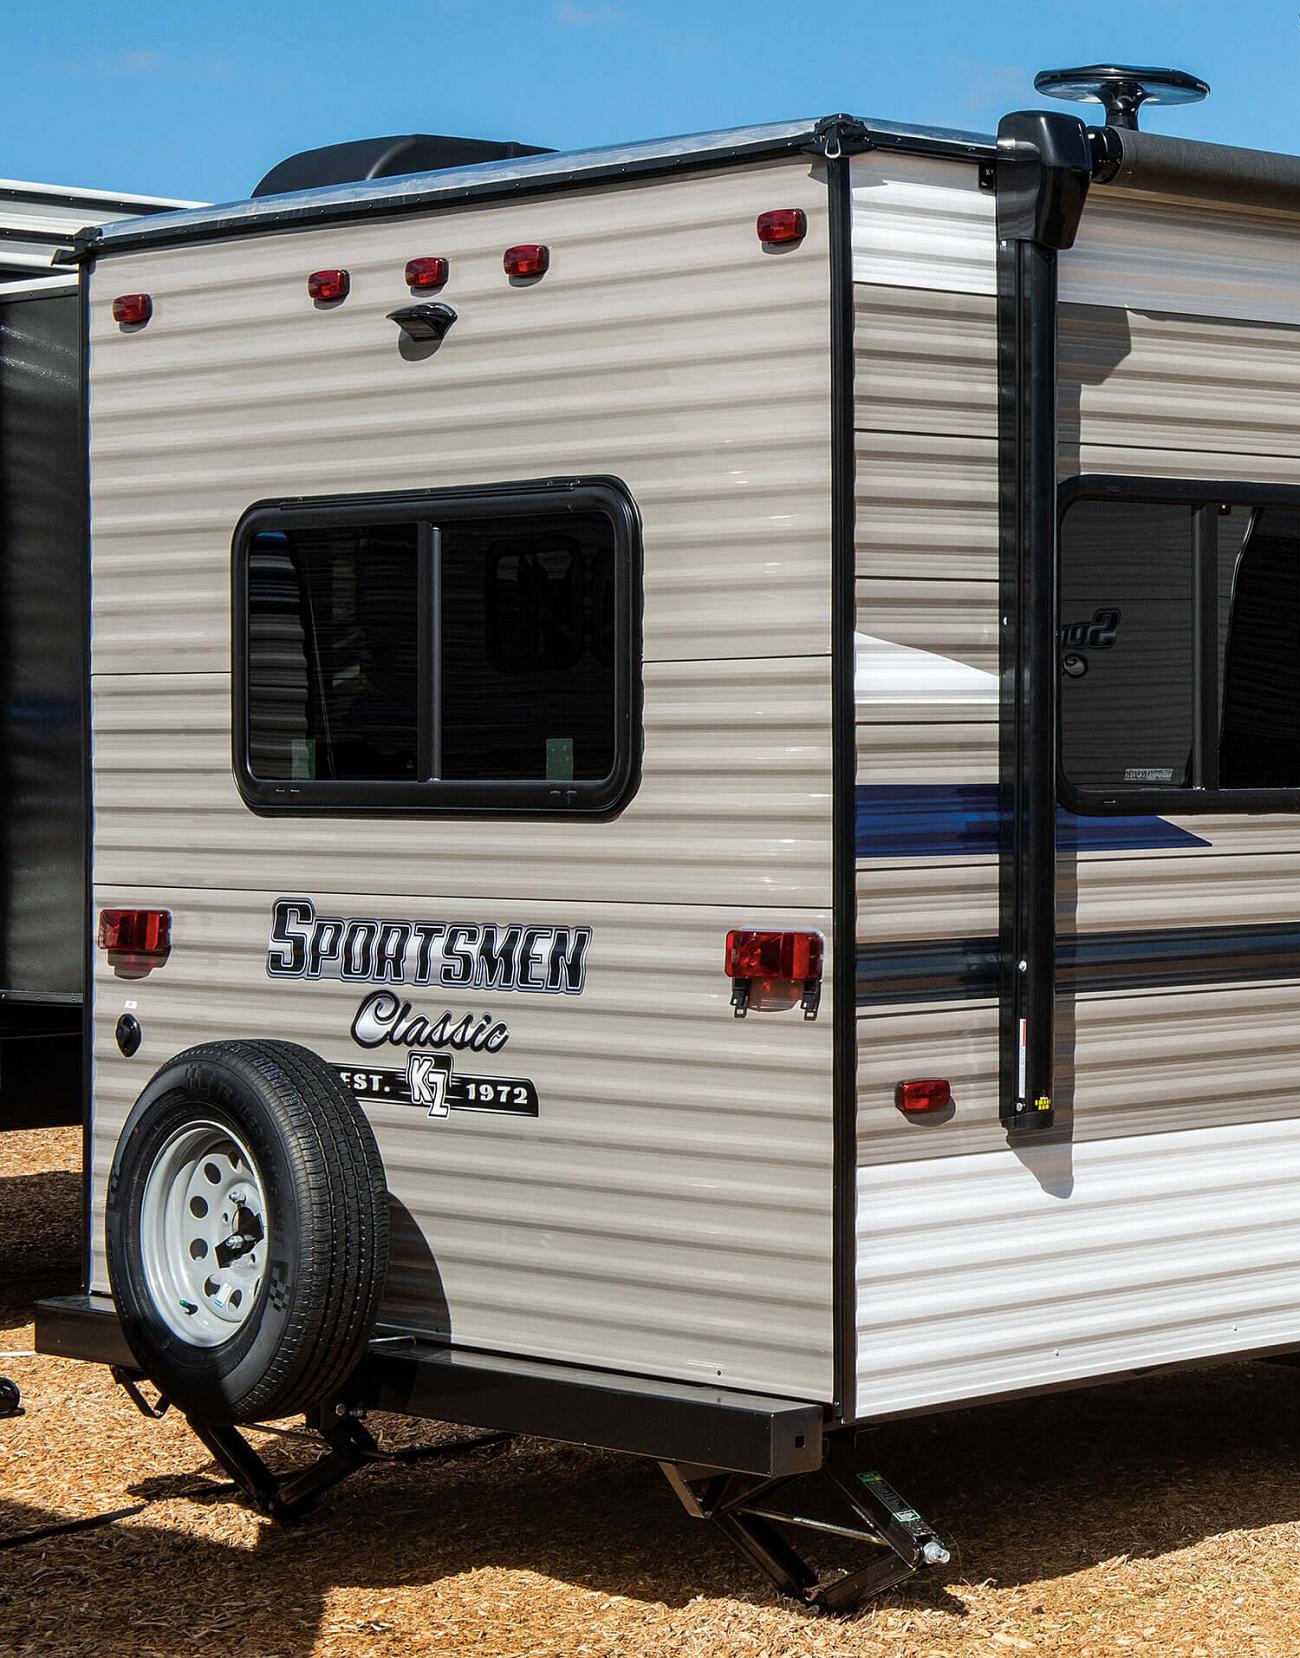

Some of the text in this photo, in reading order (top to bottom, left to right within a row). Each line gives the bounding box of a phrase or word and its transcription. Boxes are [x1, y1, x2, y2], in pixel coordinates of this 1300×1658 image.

[266, 897, 593, 995] SPORTSMEN
[351, 989, 511, 1054] Classic
[411, 1055, 450, 1119] KZ
[466, 1082, 529, 1105] 1972
